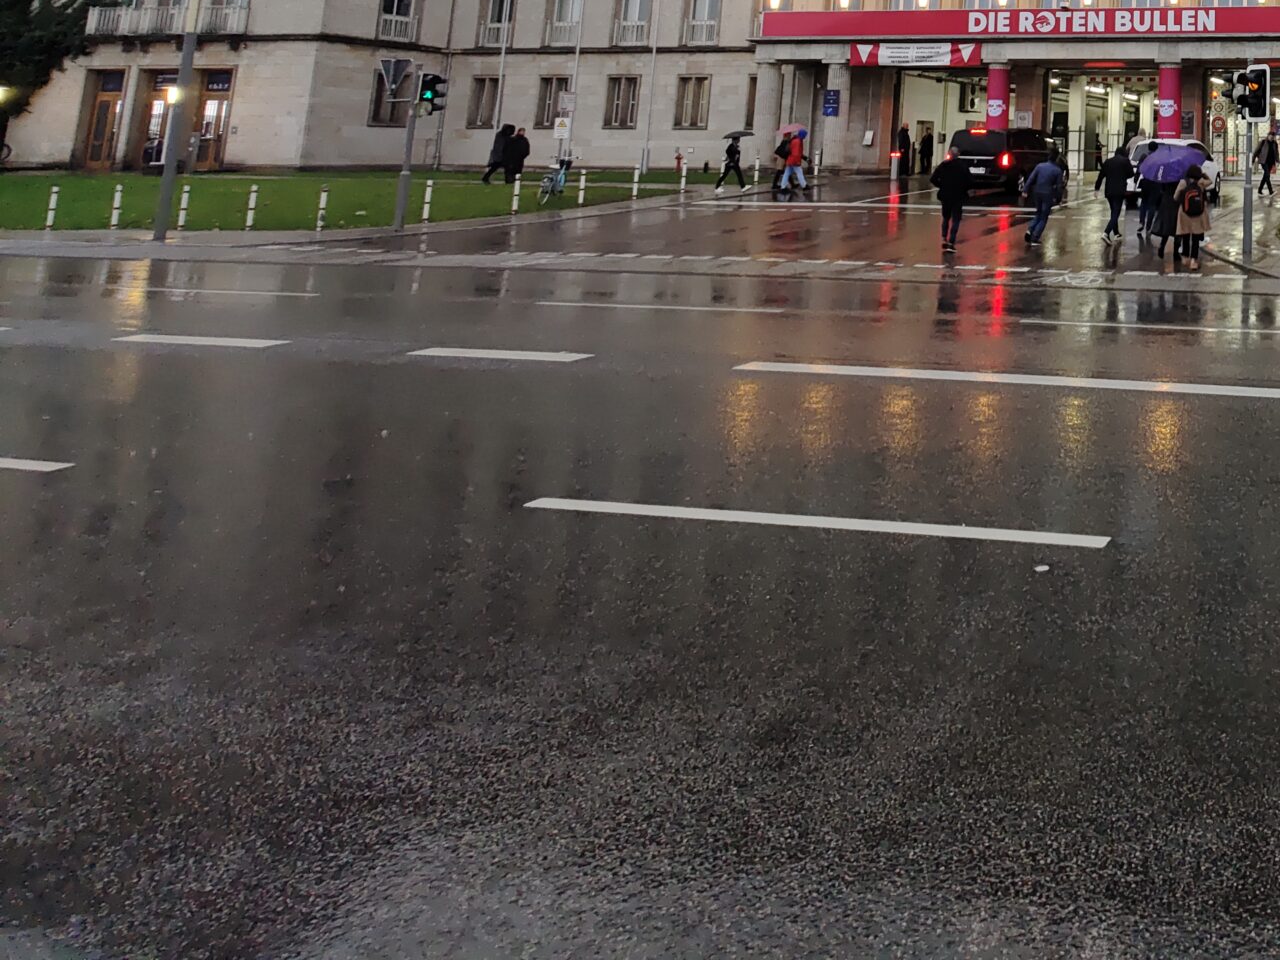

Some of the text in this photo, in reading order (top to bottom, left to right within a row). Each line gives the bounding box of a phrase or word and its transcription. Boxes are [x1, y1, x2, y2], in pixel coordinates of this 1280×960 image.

[968, 9, 1216, 33] DIE ROTEN BULLEN
